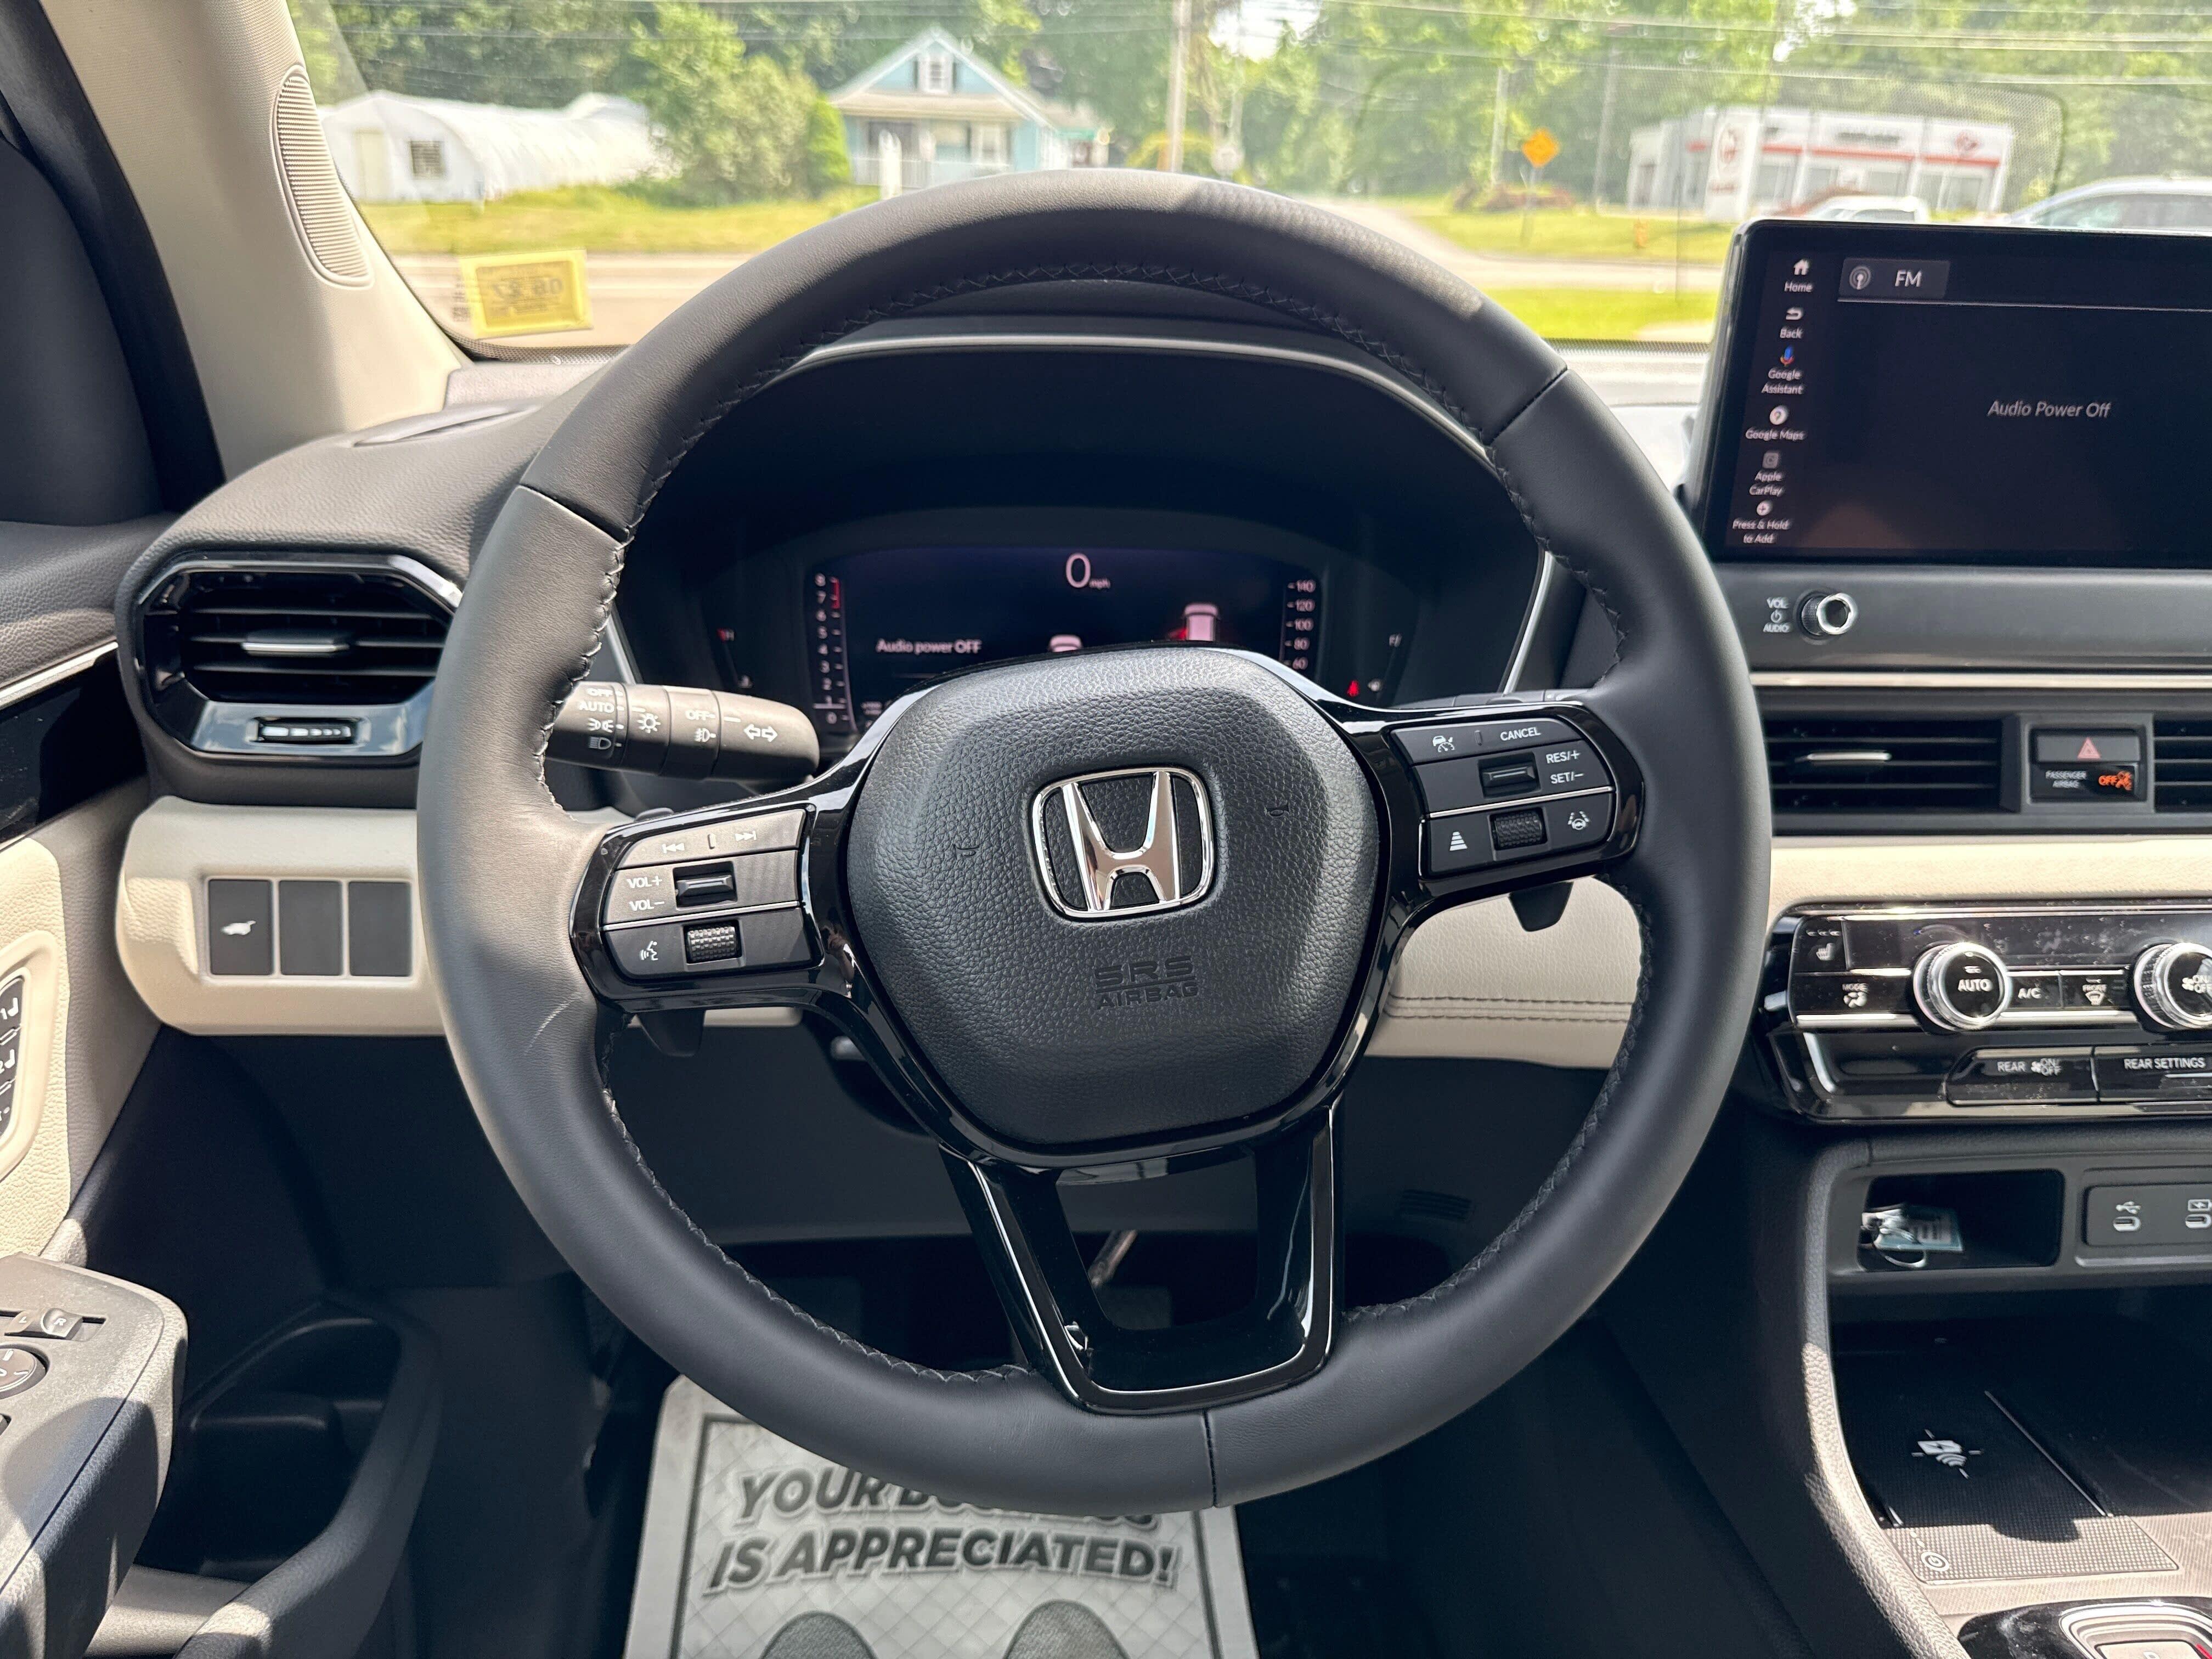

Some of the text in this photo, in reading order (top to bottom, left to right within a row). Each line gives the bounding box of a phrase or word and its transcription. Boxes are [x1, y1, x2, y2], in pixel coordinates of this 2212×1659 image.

[1895, 270, 1922, 287] FM
[1784, 281, 1813, 292] Home
[1780, 328, 1803, 338] Back
[1768, 369, 1802, 381] Google
[1762, 383, 1804, 394] Assistant
[1987, 400, 2112, 418] Audio Power Off
[1745, 428, 1806, 441] Google Maps
[1754, 471, 1782, 482] Apple
[1749, 484, 1784, 496] CarPlay
[1733, 519, 1756, 529] Press
[1767, 519, 1791, 530] Hold
[1743, 534, 1775, 544] to Add
[1066, 553, 1091, 588] 0
[1767, 597, 1788, 609] VOL
[1763, 623, 1791, 633] AUDIO
[876, 639, 981, 656] Audio power OFF
[586, 688, 613, 697] OFF
[579, 701, 614, 713] AUTO
[686, 710, 709, 720] OFF
[1500, 727, 1541, 741] CANCEL
[1546, 750, 1580, 763] RES/+
[627, 876, 662, 888] VOL+
[1098, 956, 1193, 985] SRS
[1957, 979, 1993, 992] AUTO
[1098, 983, 1198, 1009] AIRBAG
[2018, 989, 2041, 999] A/C
[1997, 1061, 2025, 1071] REAR
[2124, 1058, 2205, 1069] REAR SETTINGS
[2041, 1065, 2061, 1076] OFF
[53, 1318, 66, 1326] R
[741, 1467, 884, 1518] YOUR
[711, 1527, 1173, 1587] IS APPRECIATED!
